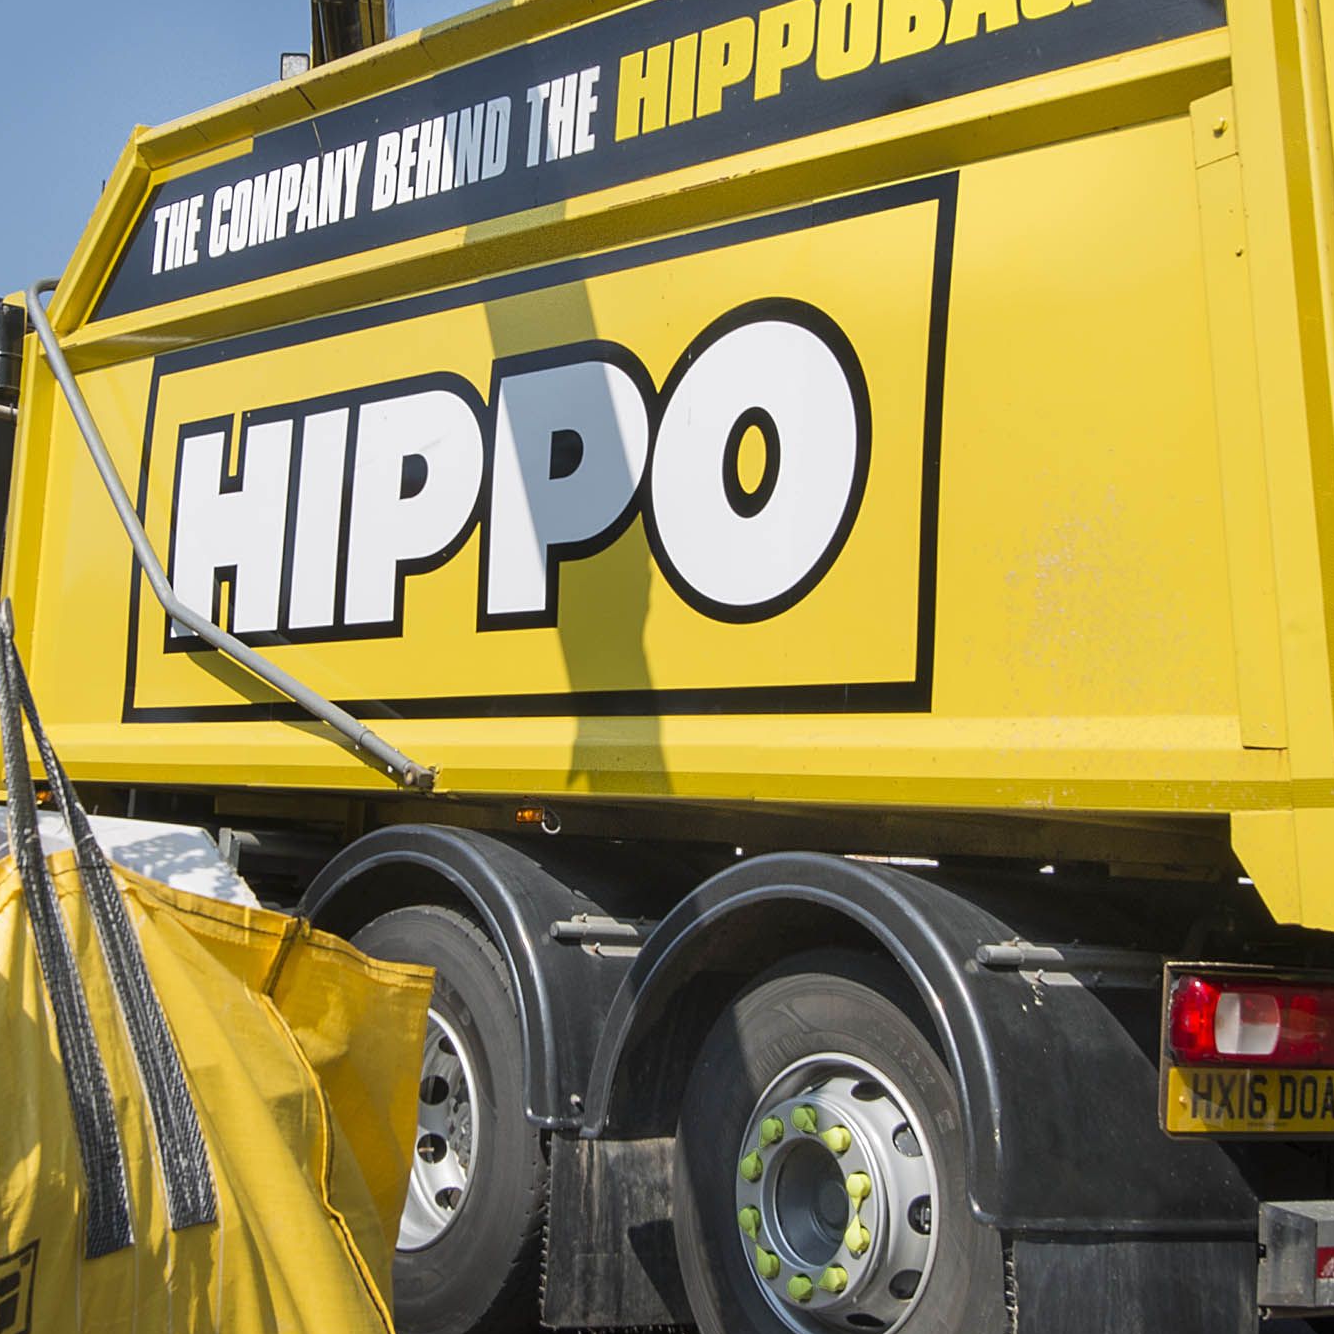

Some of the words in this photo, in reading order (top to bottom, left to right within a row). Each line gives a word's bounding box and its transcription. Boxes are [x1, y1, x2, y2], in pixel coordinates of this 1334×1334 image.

[152, 203, 204, 276] THE
[208, 140, 368, 258] COMPANY
[372, 95, 509, 215] BEHIND
[524, 64, 601, 167] THE
[165, 298, 871, 653] HIPPO
[1191, 1073, 1267, 1120] HX16
